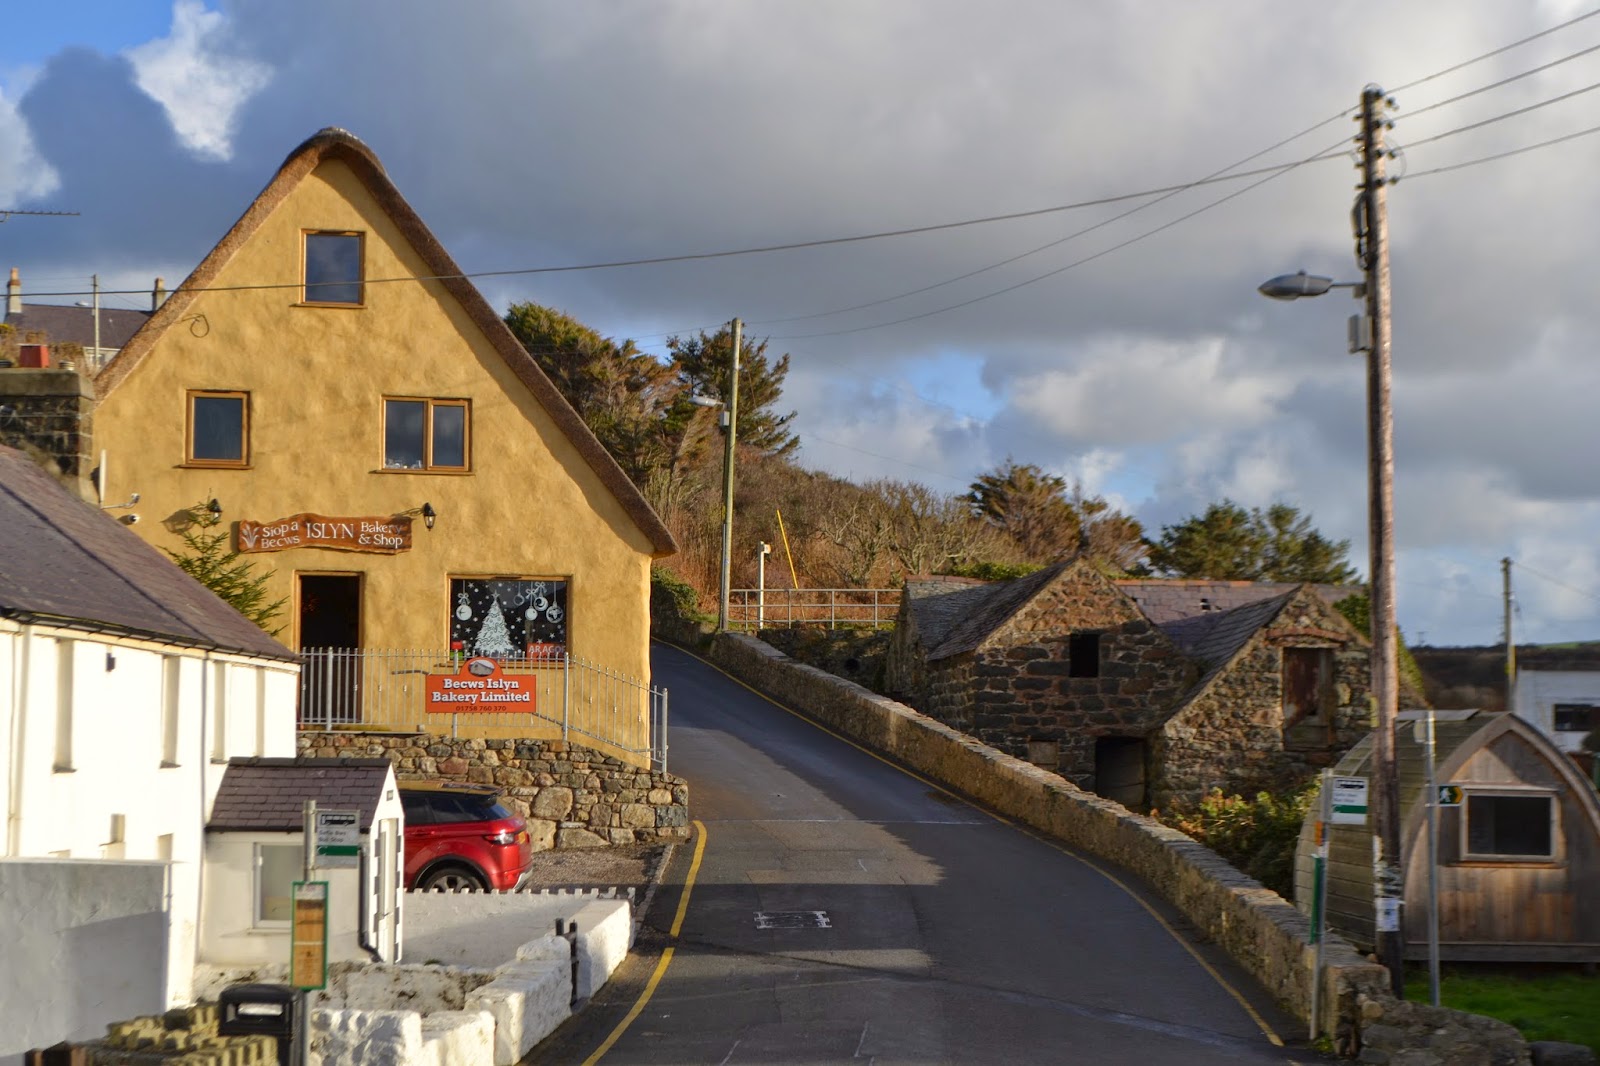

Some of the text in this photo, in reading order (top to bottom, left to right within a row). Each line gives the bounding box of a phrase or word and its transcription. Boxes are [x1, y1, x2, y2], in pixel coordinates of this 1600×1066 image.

[262, 521, 299, 538] Siop a
[306, 522, 354, 539] ISLYN
[361, 521, 402, 535] Bakery
[260, 535, 300, 549] Becws
[358, 533, 403, 549] & Shop
[443, 678, 520, 692] Becws Islyn
[431, 691, 531, 705] Bakery Limited
